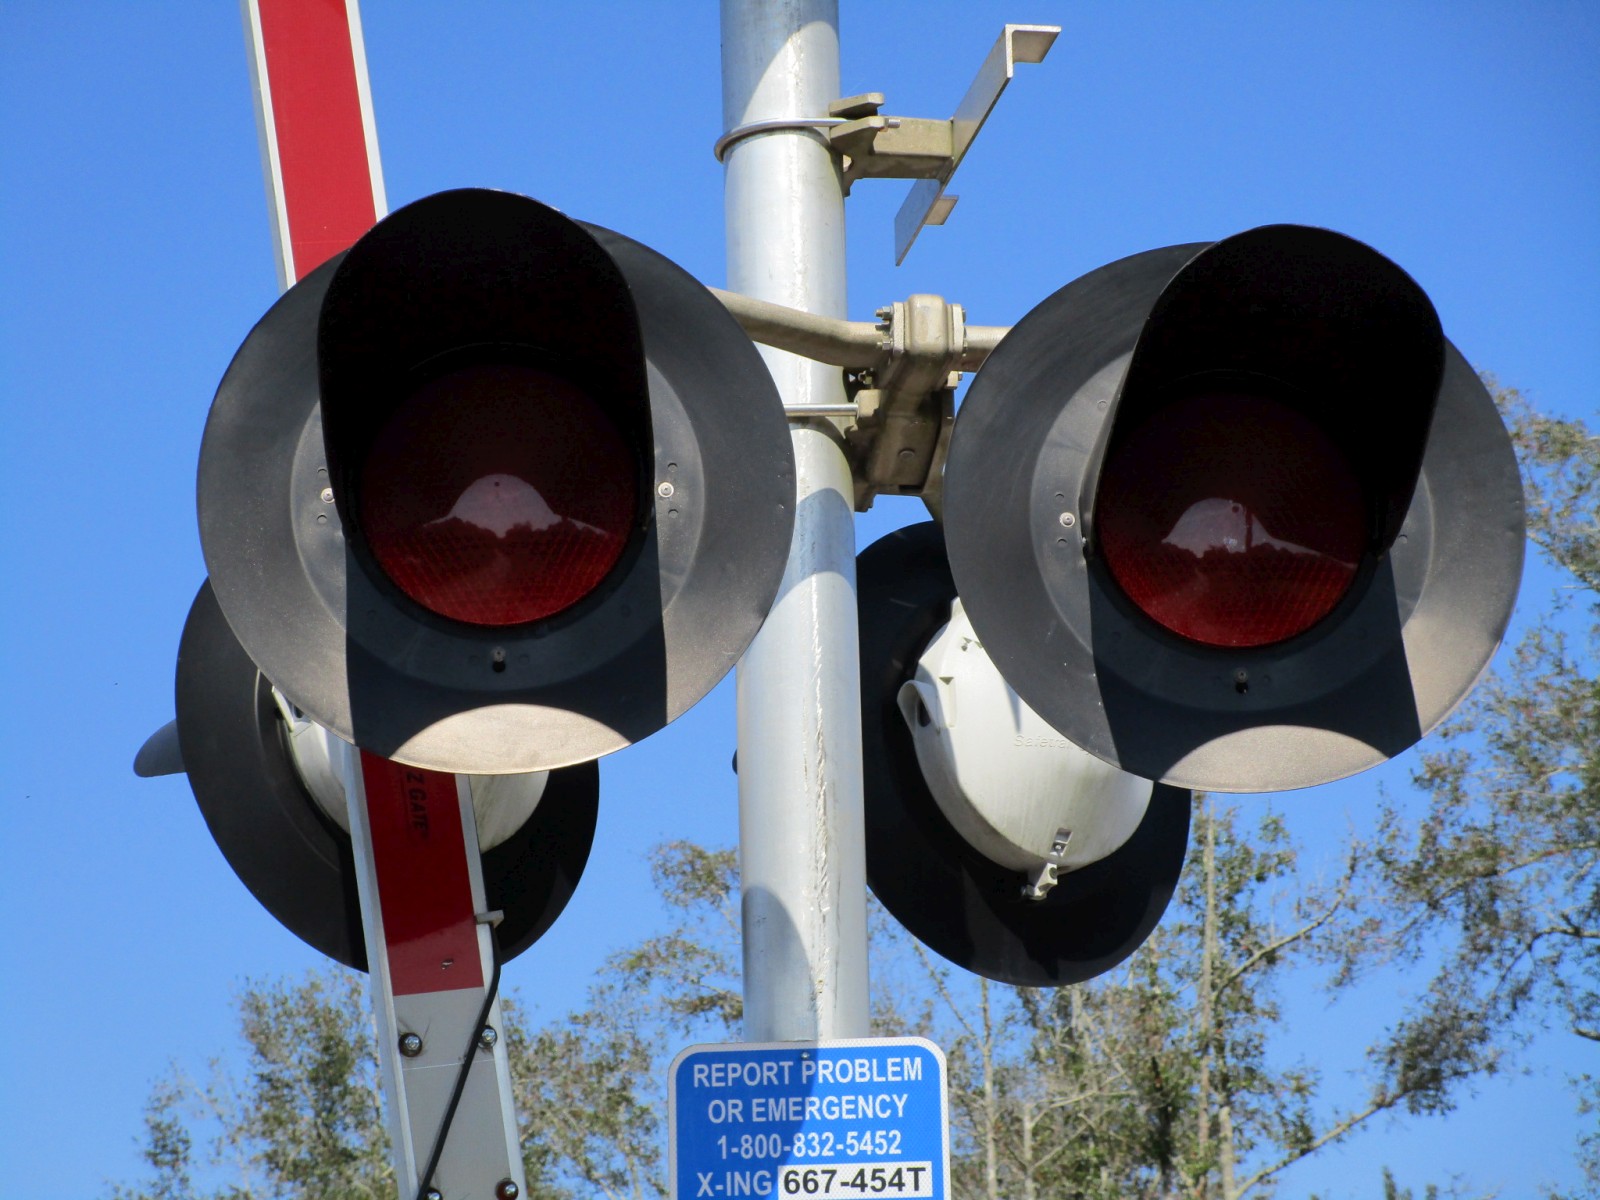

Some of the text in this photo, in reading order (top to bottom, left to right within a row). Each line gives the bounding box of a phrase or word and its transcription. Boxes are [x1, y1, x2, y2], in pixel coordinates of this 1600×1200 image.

[693, 1056, 923, 1088] REPORT PROBLEM
[707, 1093, 908, 1124] OR EMERGENCY
[717, 1129, 902, 1160] 1-800-832-5452
[696, 1166, 926, 1198] X-ING 667-454T
